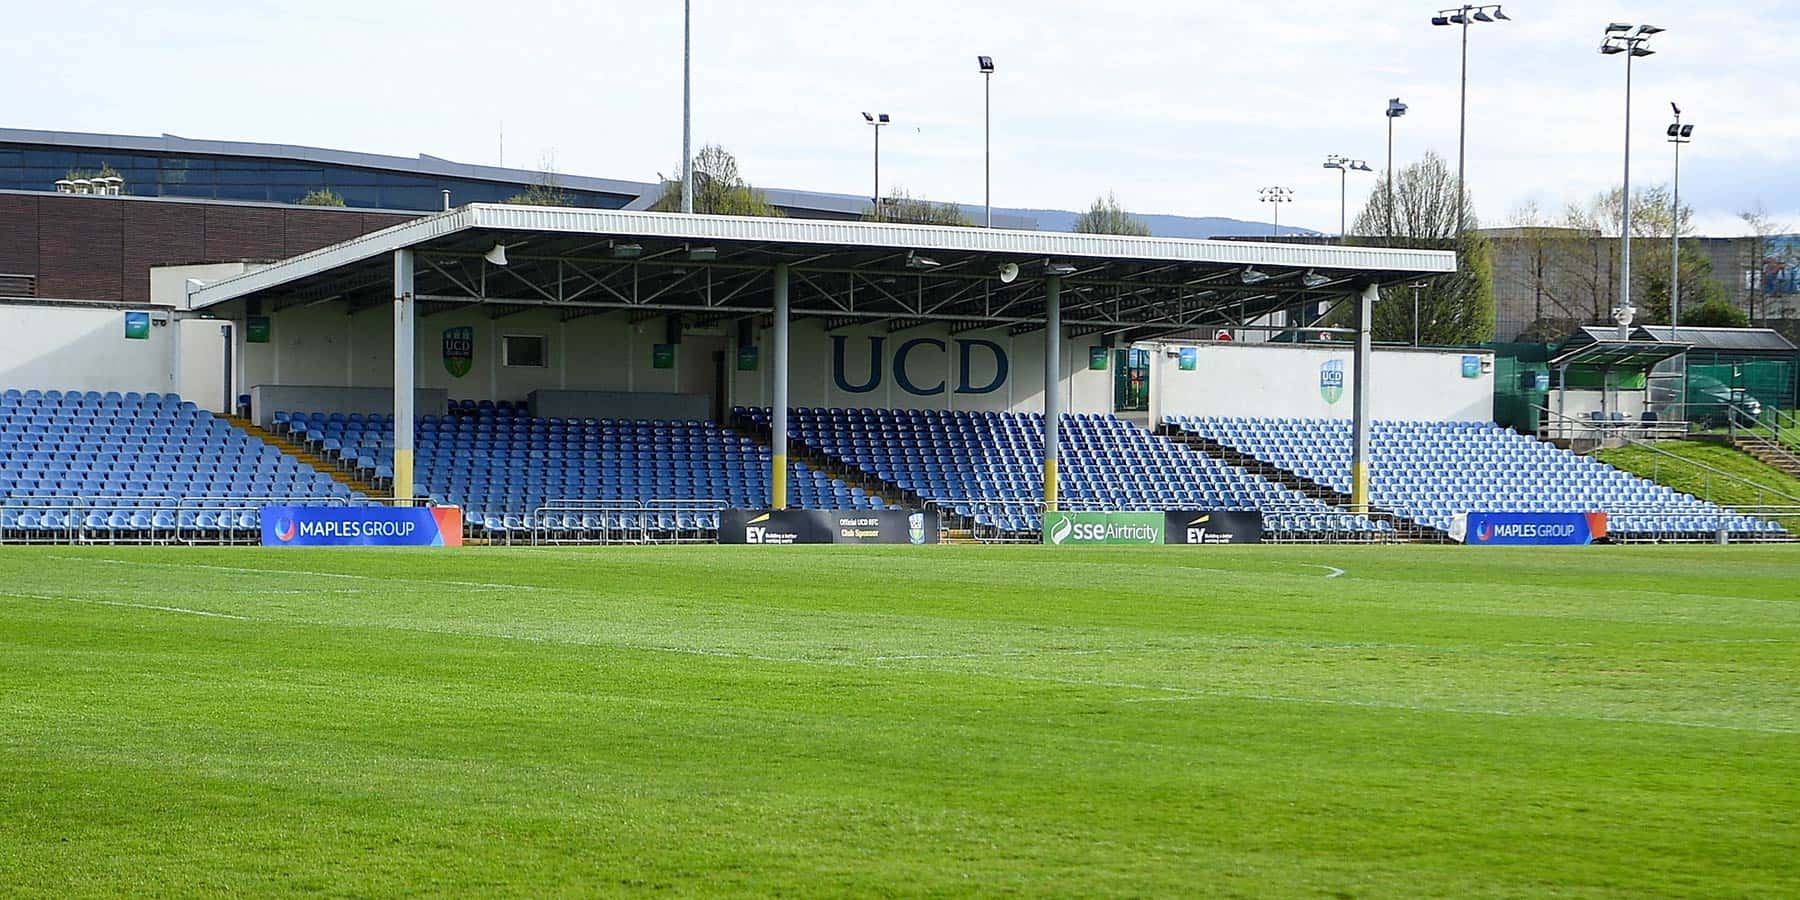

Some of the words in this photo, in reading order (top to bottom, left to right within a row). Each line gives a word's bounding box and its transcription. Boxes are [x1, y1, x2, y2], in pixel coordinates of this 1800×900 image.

[446, 340, 471, 351] UCD
[829, 335, 1009, 396] UCD
[1322, 371, 1342, 381] UCD
[300, 521, 360, 537] MAPLES
[362, 521, 415, 536] GROUP
[746, 526, 766, 544] EY
[1073, 523, 1104, 541] sse
[1105, 521, 1159, 543] Airtricity
[1187, 527, 1206, 544] EY
[1494, 524, 1536, 537] MAPLES
[1538, 524, 1575, 537] GROUP
